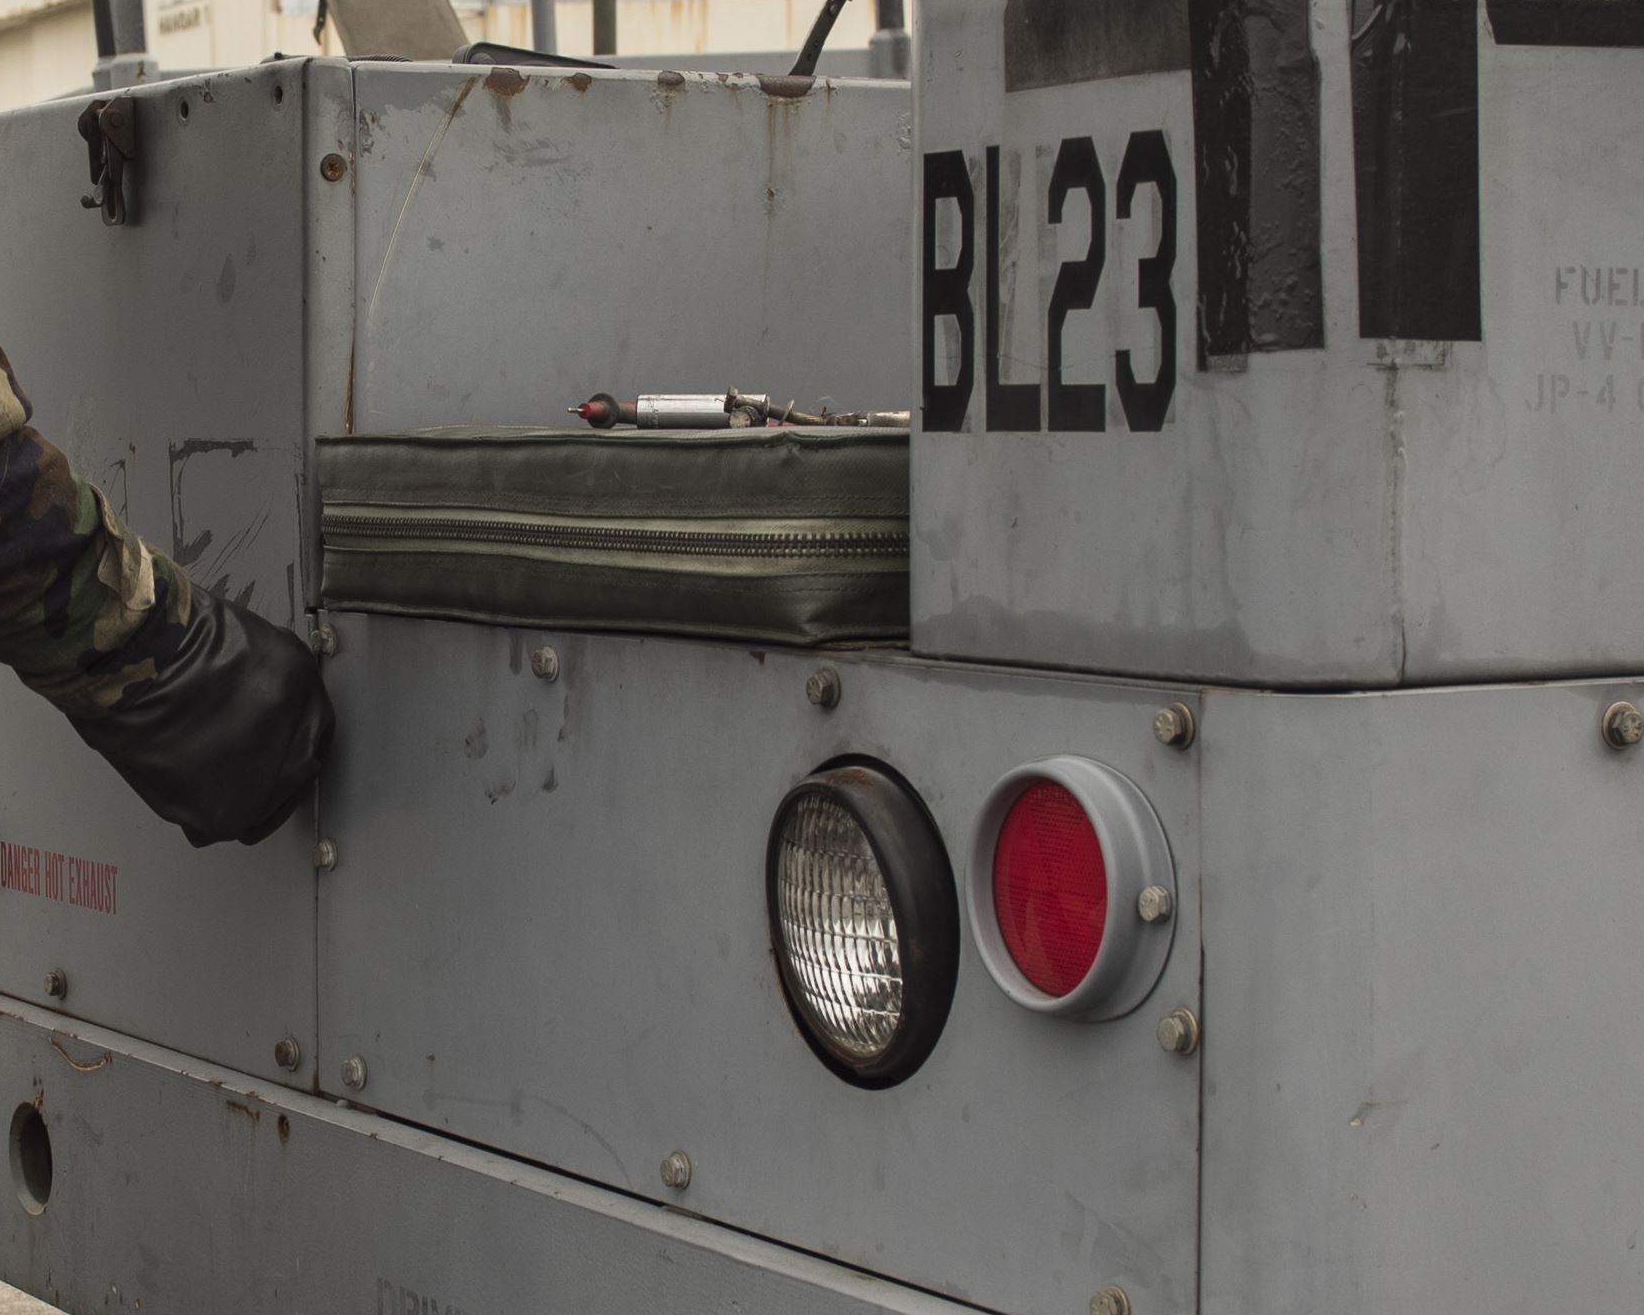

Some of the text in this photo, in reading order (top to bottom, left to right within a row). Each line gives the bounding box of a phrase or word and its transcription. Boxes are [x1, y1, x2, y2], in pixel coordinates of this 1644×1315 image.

[922, 129, 1177, 432] BL23
[1524, 373, 1617, 415] JP-4
[0, 840, 118, 916] DANGER HOT EXHAUST
